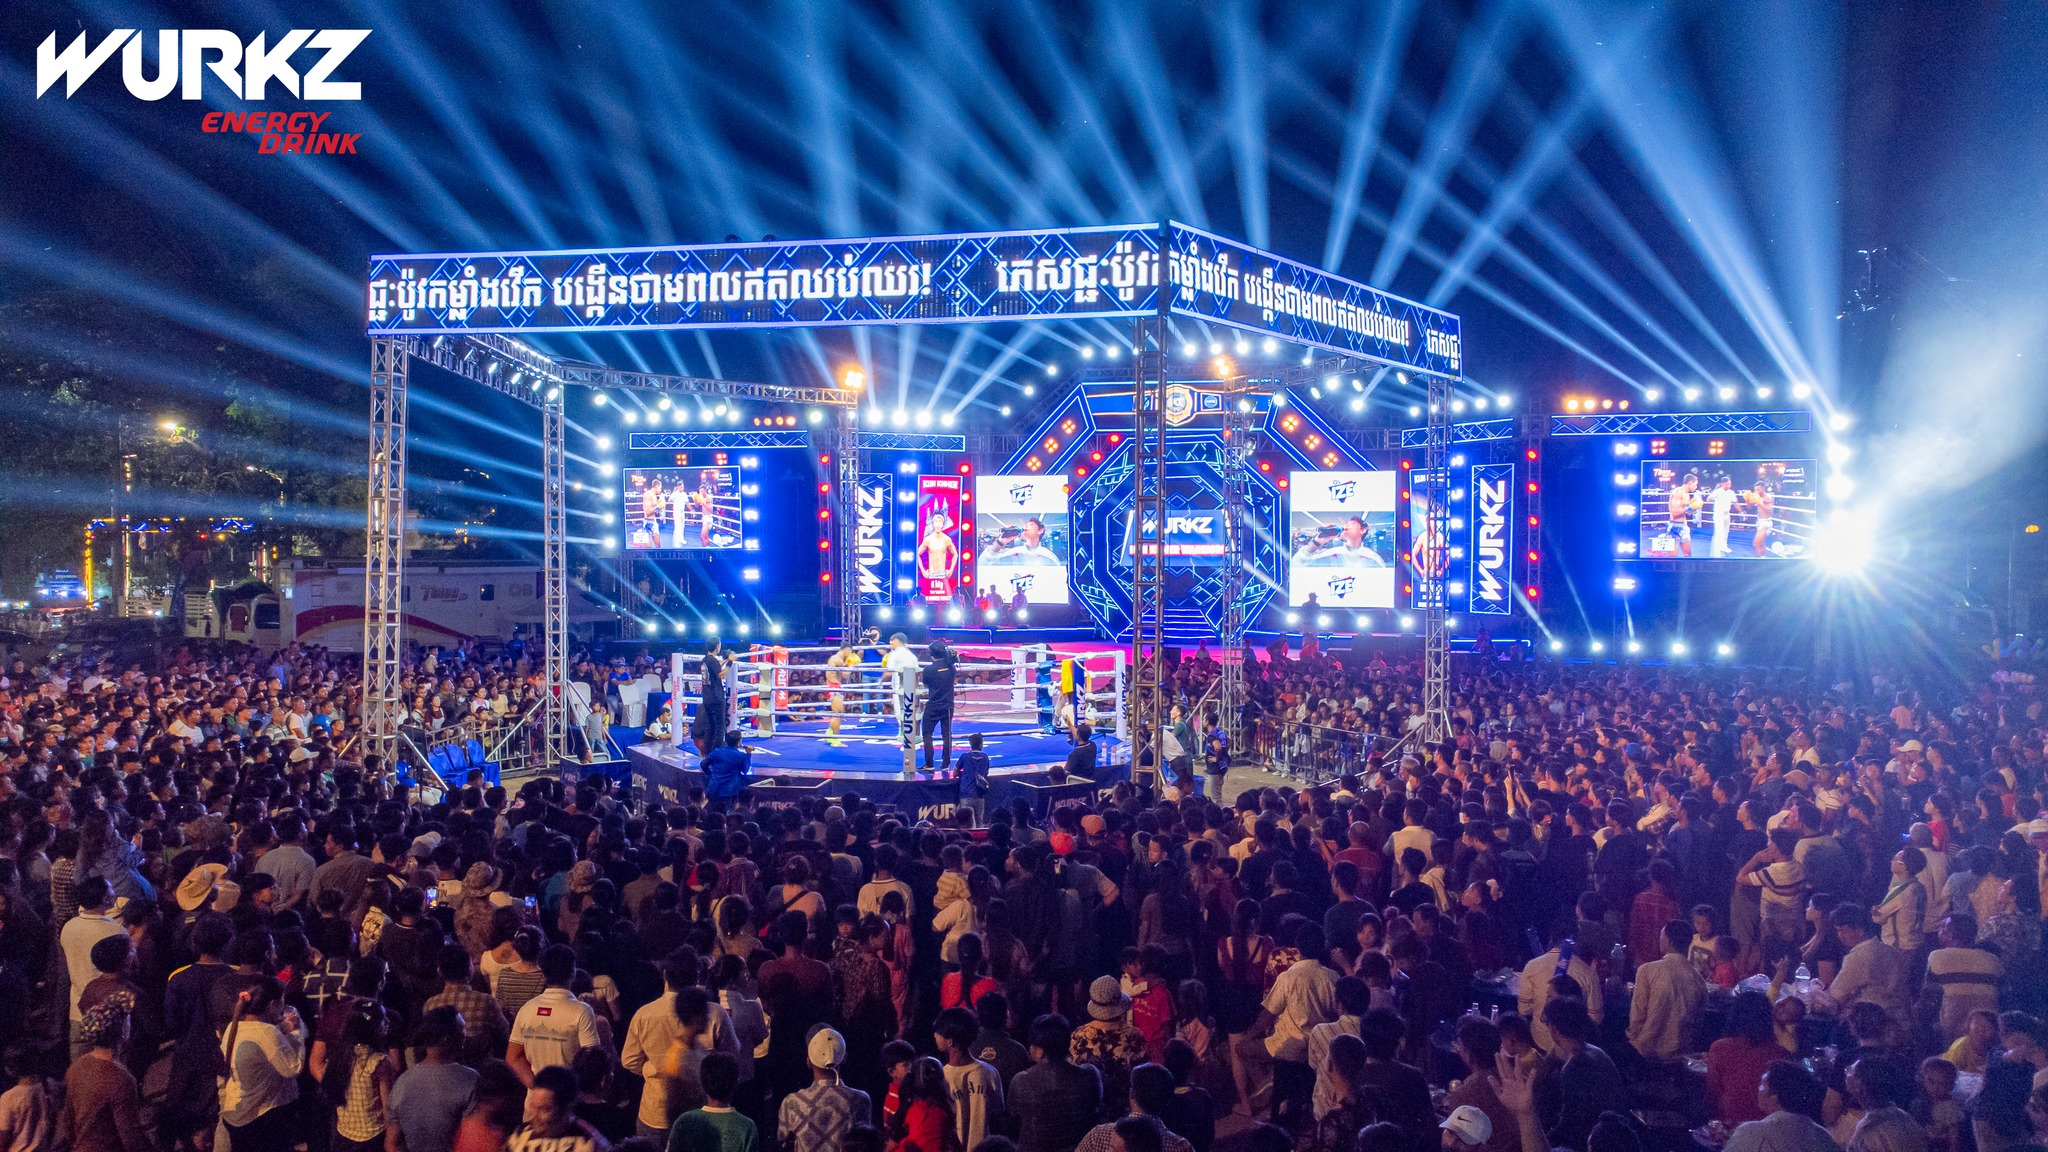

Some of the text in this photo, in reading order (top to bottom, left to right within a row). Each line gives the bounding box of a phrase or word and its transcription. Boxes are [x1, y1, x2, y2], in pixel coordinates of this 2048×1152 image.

[1012, 486, 1032, 503] IZE
[1330, 483, 1354, 500] IZE
[857, 487, 883, 593] WURKZ
[1479, 478, 1505, 600] WURKZ
[1330, 578, 1353, 596] IZE
[1076, 683, 1086, 726] URKZ
[903, 692, 914, 749] WURKZ
[918, 803, 957, 821] WUR
